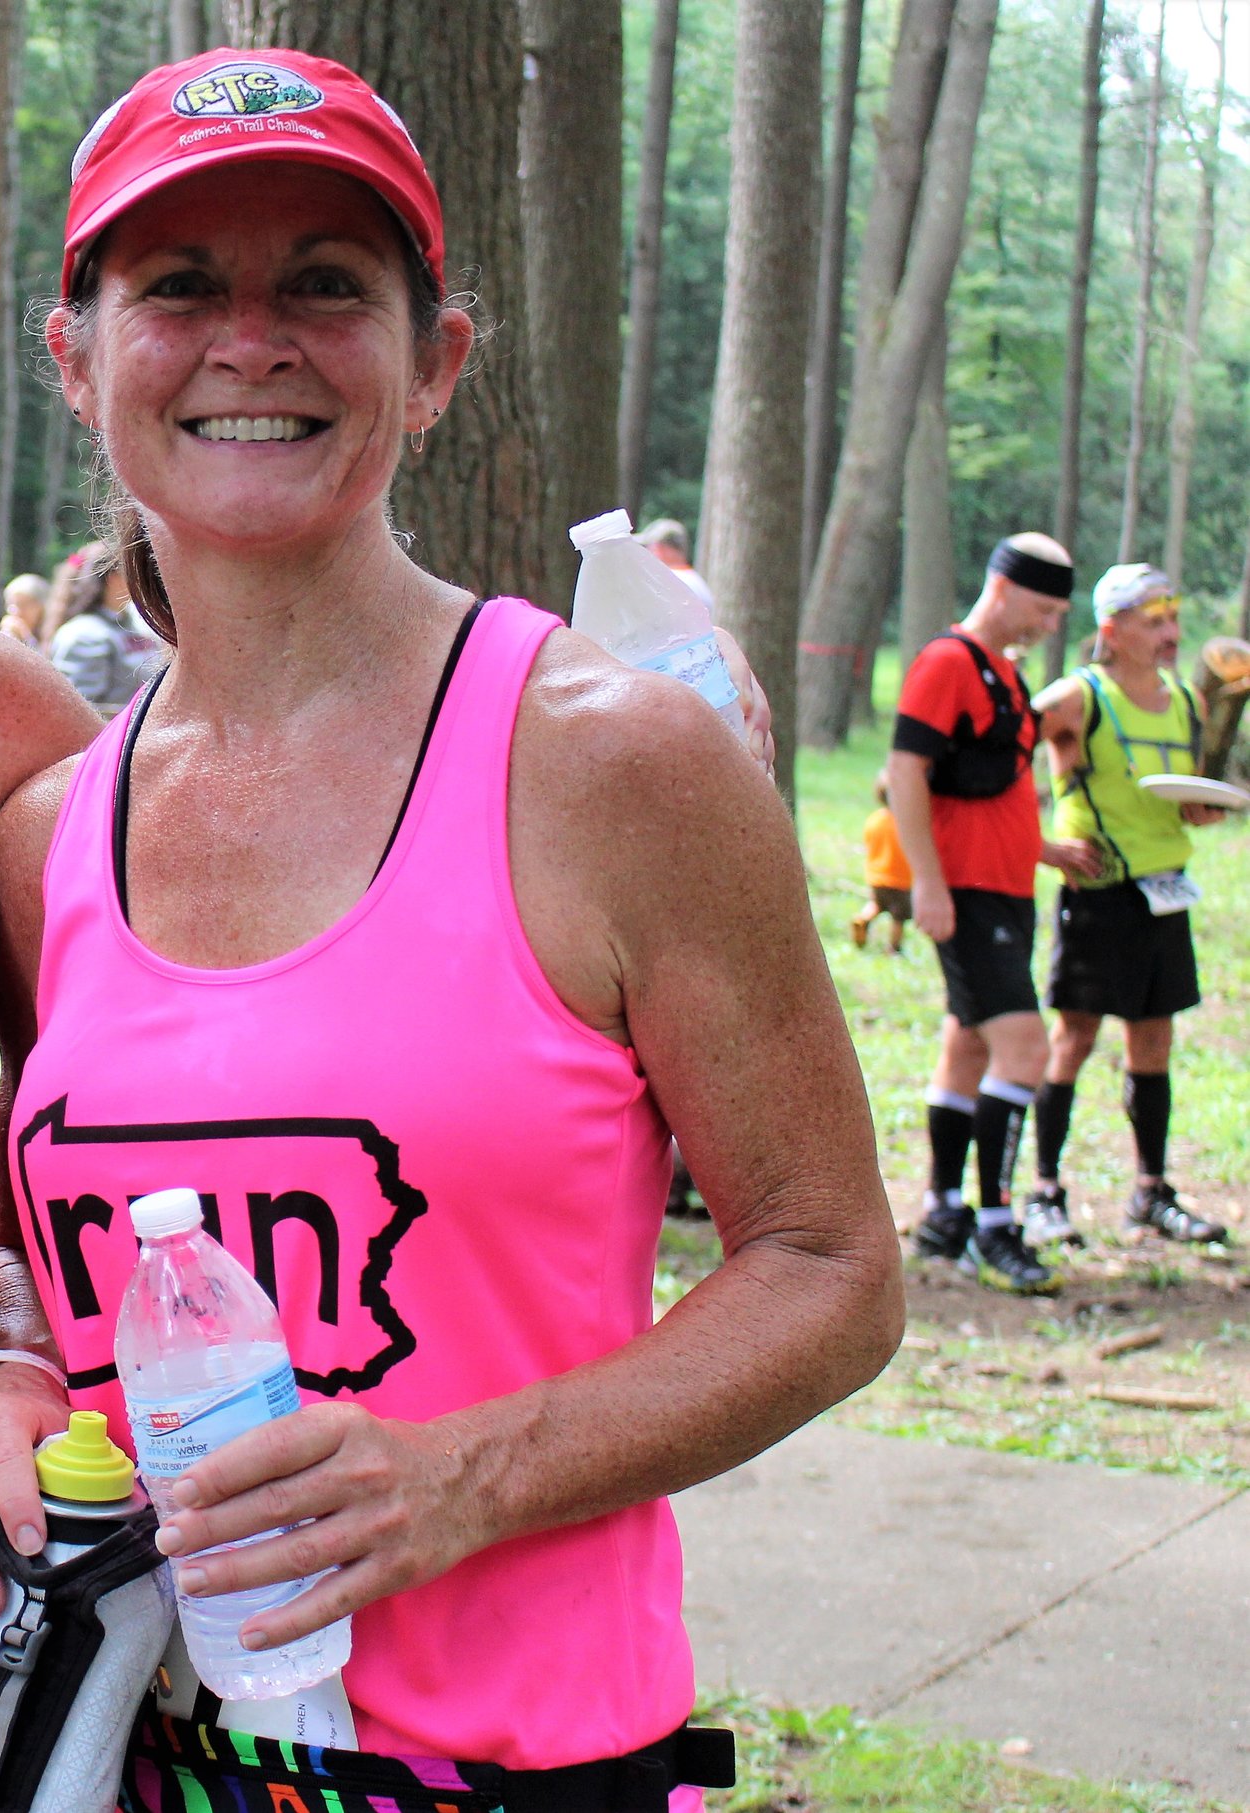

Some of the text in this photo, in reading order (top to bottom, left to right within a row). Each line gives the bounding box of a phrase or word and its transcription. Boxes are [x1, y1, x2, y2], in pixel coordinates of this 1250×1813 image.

[183, 71, 279, 114] RTC
[178, 117, 327, 148] Rothrock Trail Challenge
[152, 1414, 179, 1424] weis
[151, 1436, 193, 1446] purified
[297, 1703, 305, 1736] KAREN
